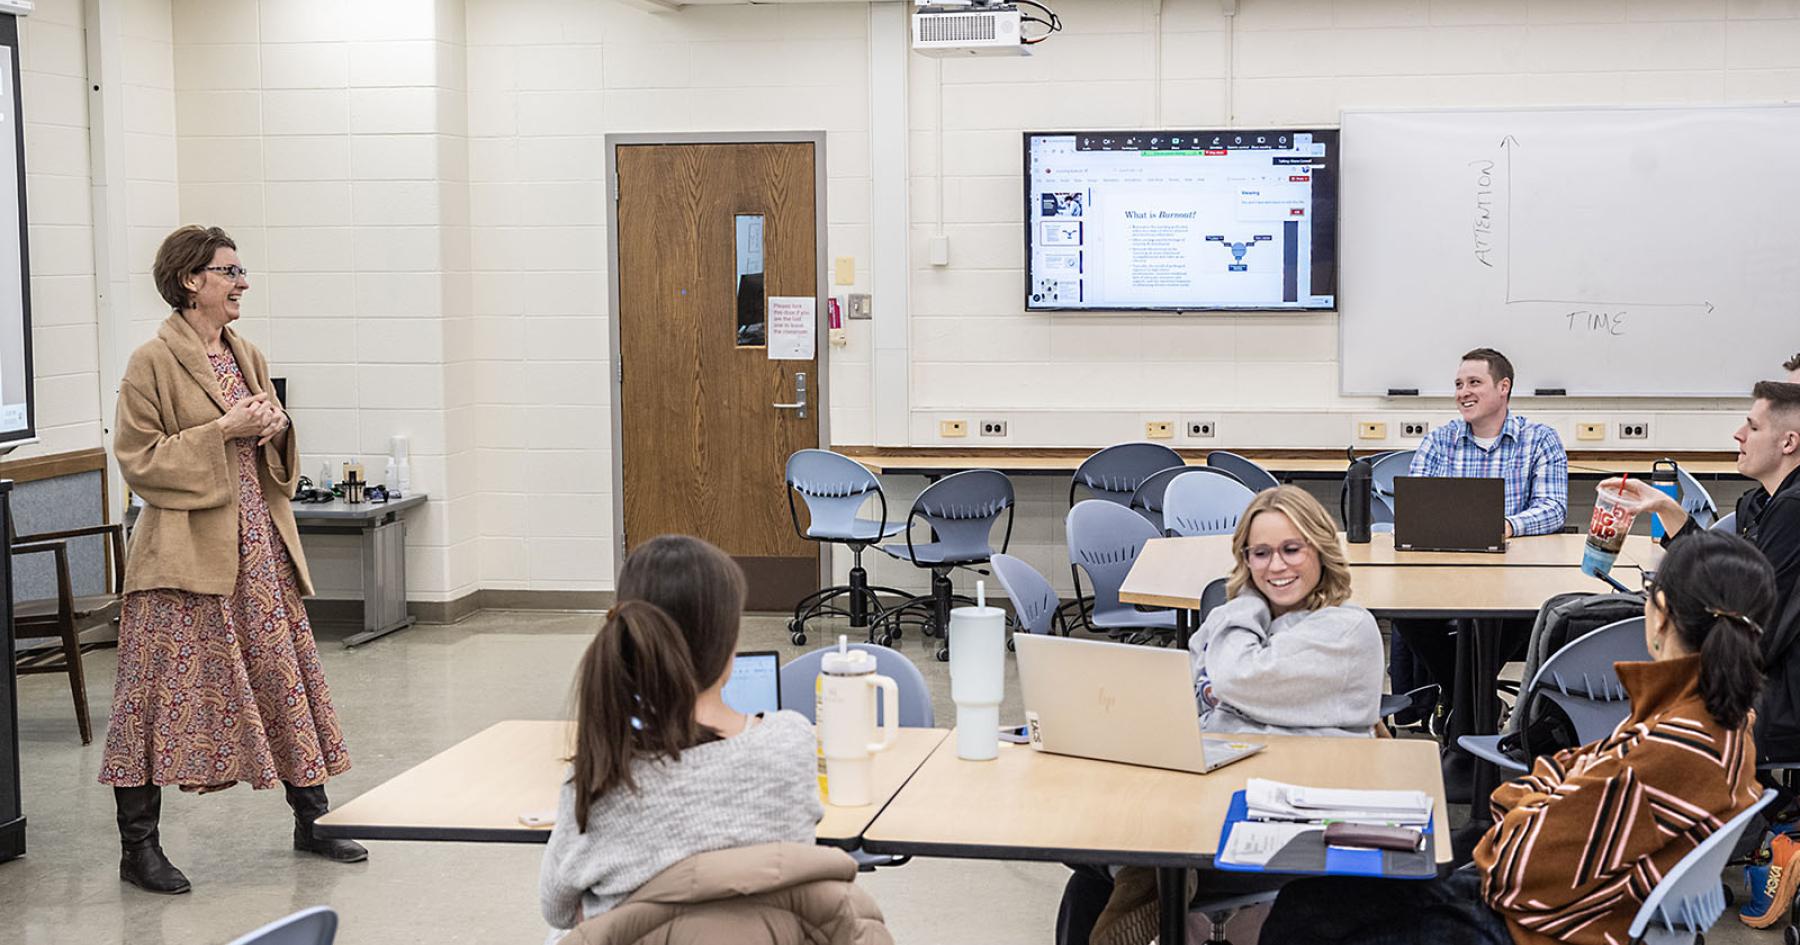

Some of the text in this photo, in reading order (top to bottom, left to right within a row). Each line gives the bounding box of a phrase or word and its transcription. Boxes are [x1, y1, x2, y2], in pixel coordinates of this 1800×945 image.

[1125, 211, 1147, 219] What
[1150, 211, 1157, 219] is
[1468, 159, 1495, 267] ATTENTION
[1566, 310, 1628, 336] TIME
[1764, 865, 1783, 898] HOKA
